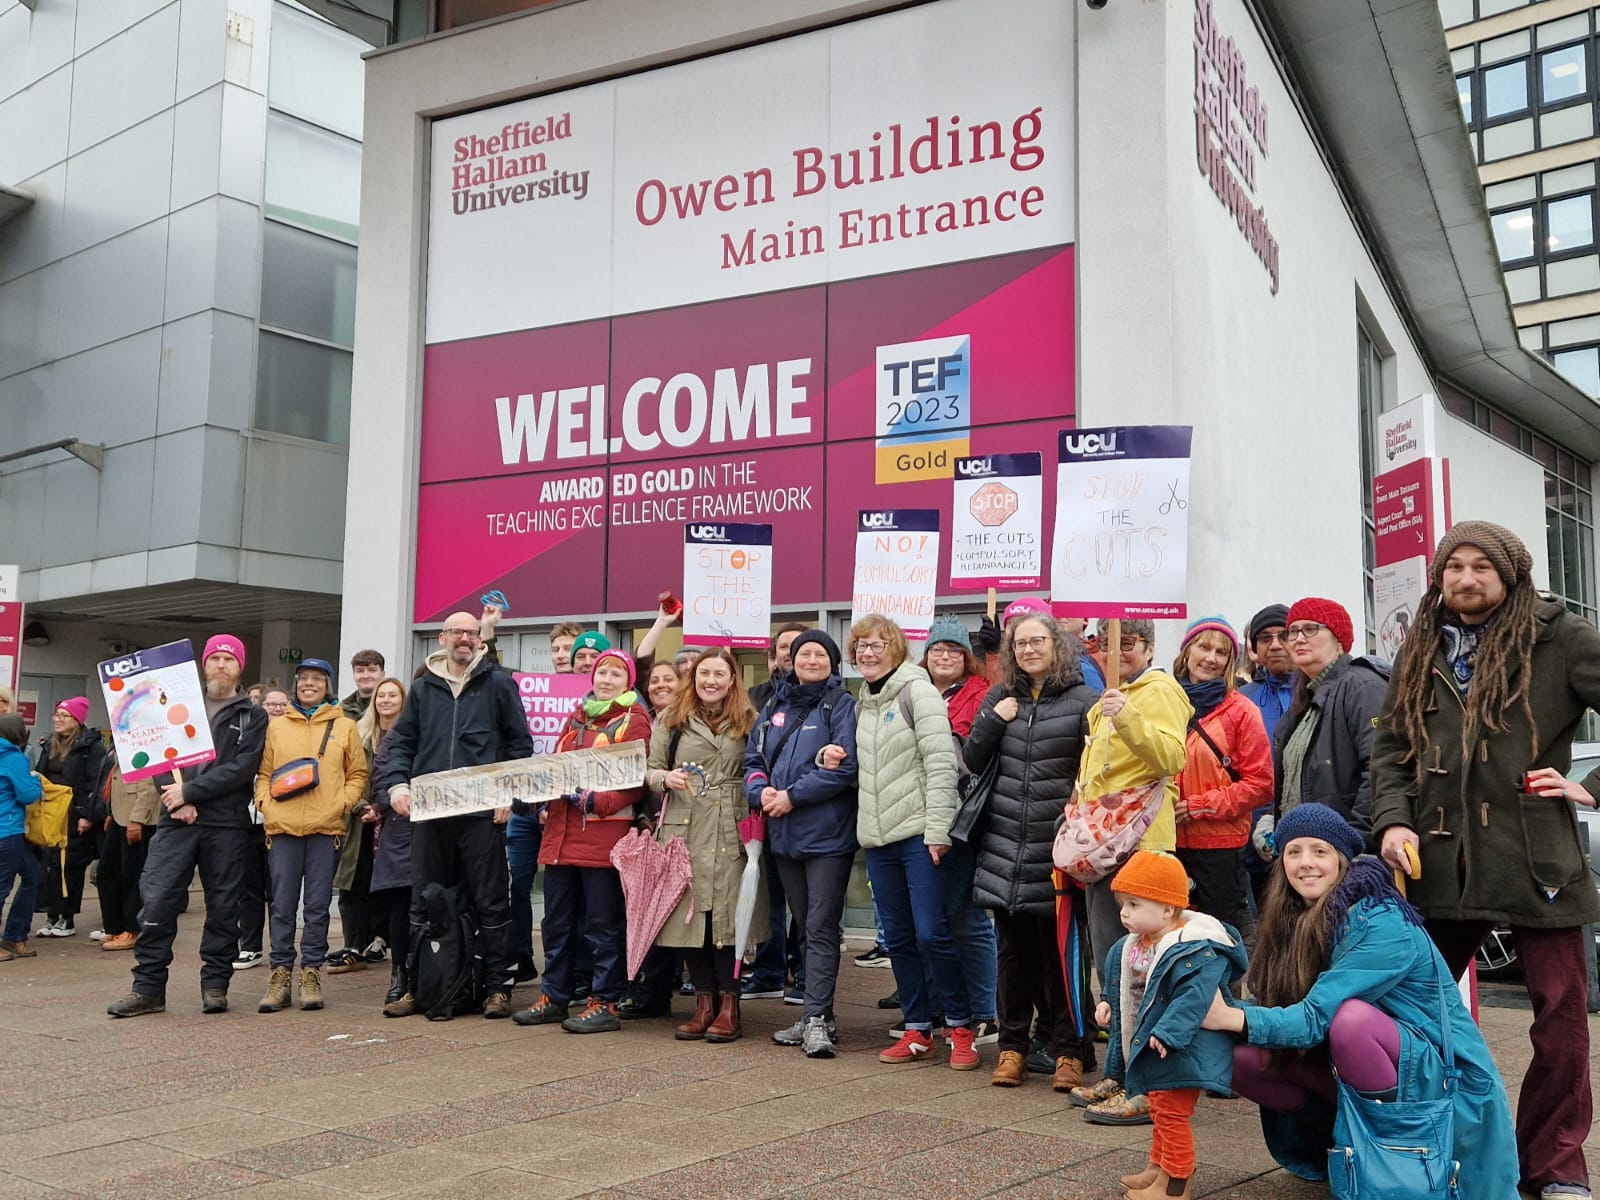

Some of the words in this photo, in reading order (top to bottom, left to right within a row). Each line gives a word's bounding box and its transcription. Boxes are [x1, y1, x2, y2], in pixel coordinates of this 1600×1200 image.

[1194, 41, 1257, 195] Hallam
[454, 112, 572, 163] Sheffield
[452, 152, 547, 190] Hallam
[635, 179, 776, 226] Owen
[792, 106, 1046, 198] Building
[452, 169, 590, 216] University
[1193, 102, 1280, 297] University
[721, 220, 825, 270] Main
[838, 185, 1045, 249] Entrance
[883, 354, 963, 396] TEF
[495, 358, 812, 464] WELCOME
[886, 395, 960, 427] 2023
[1385, 419, 1412, 438] Sheffield
[1385, 433, 1408, 449] Hallam
[896, 450, 948, 471] Gold
[641, 467, 695, 494] GOLD
[698, 465, 716, 488] IN
[721, 460, 757, 486] THE
[487, 508, 567, 535] TEACHING
[692, 486, 813, 519] FRAMEWORK
[974, 493, 1015, 510] STOP
[1096, 509, 1134, 526] THE
[965, 533, 991, 545] THE
[997, 533, 1035, 545] CUTS
[698, 547, 762, 571] STOP
[959, 549, 1036, 561] COMPULSORY
[960, 561, 1037, 571] REDUNDANCIES
[1063, 527, 1168, 581] CUTS
[706, 575, 756, 594] THE
[693, 595, 763, 618] CUTS
[853, 592, 935, 617] REDUNDANCIES
[1124, 607, 1179, 615] www.ucu.org.uk
[520, 676, 550, 694] ON
[521, 696, 583, 714] STRIK
